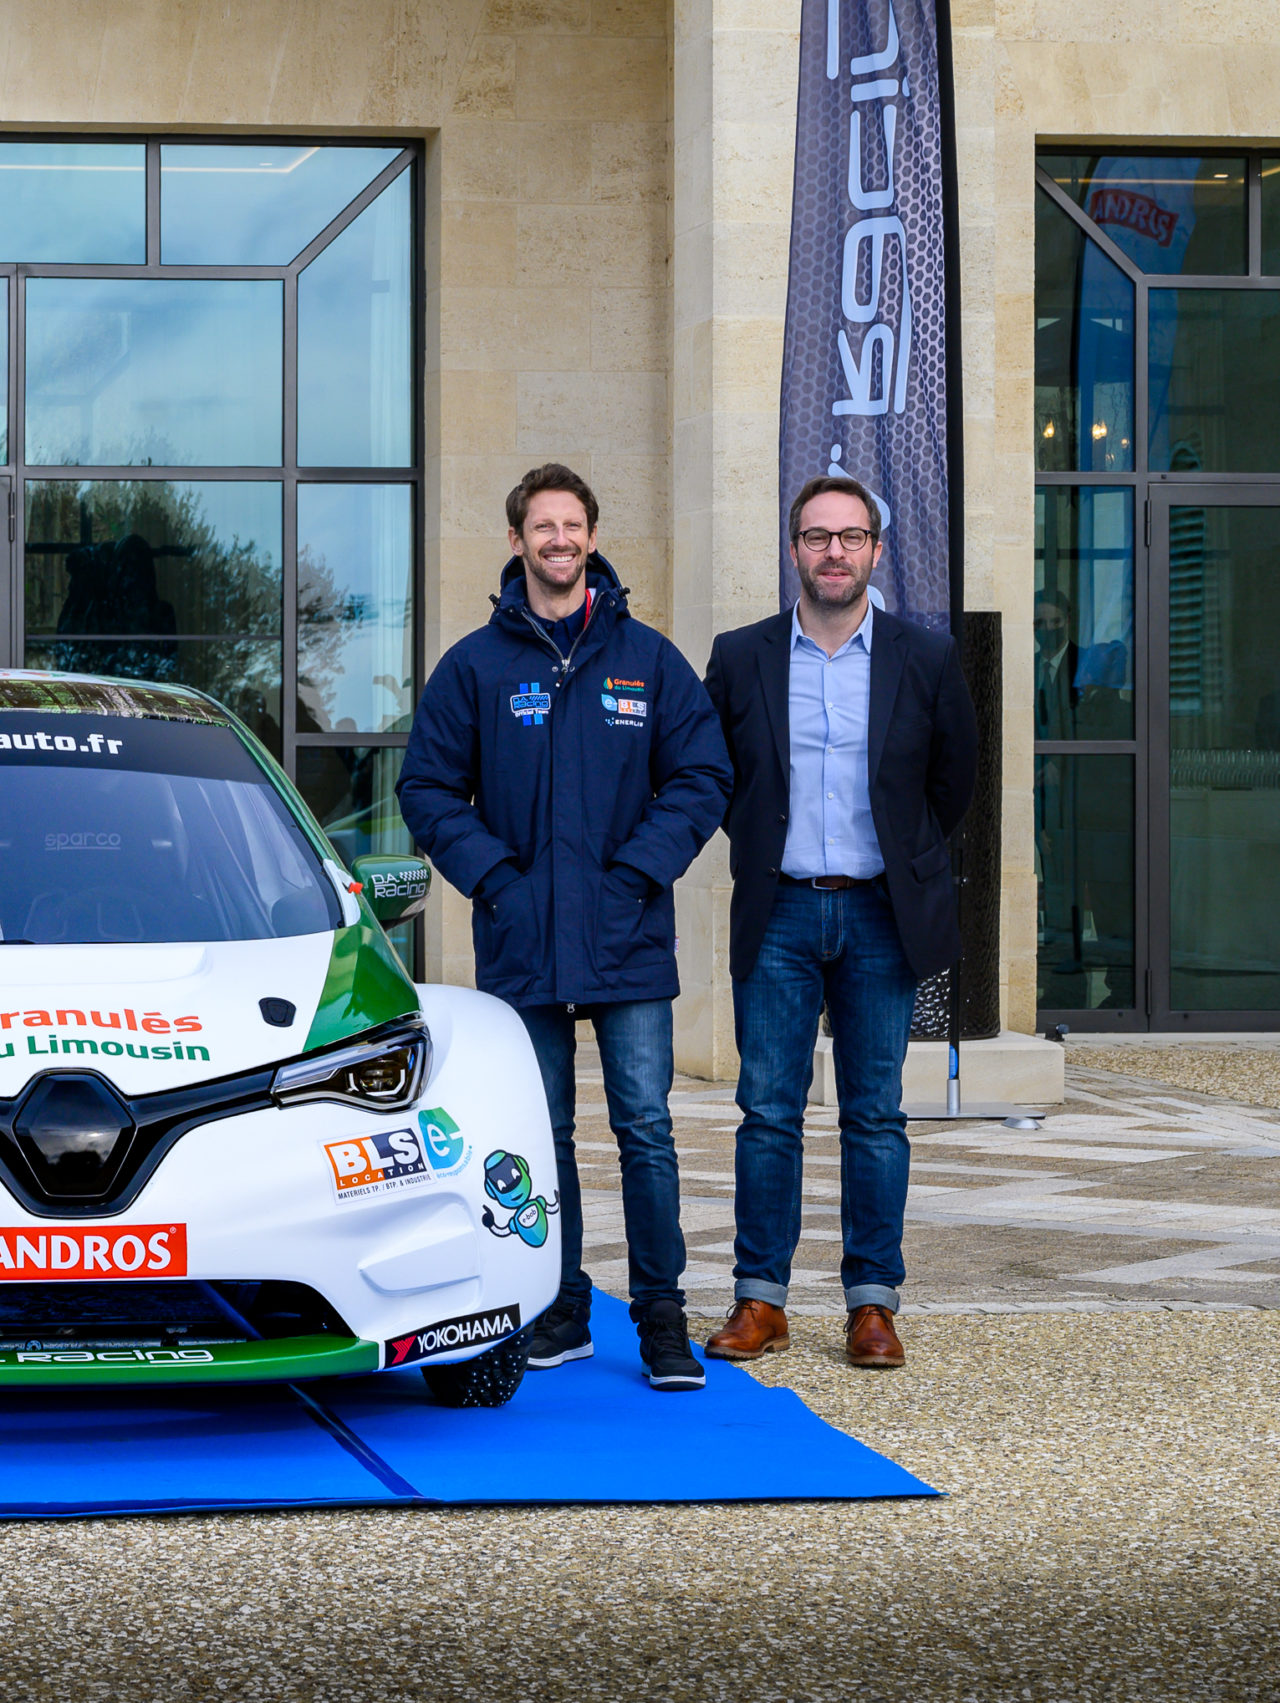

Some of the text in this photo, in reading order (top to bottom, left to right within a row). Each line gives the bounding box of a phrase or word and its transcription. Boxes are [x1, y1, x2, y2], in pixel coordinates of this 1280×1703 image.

[45, 832, 121, 851] sparco
[374, 882, 426, 899] Racing
[27, 1035, 210, 1061] Limousin
[329, 1132, 420, 1177] BLS
[338, 1187, 371, 1200] MATERIELS
[405, 1174, 432, 1186] INDUSTRIE
[339, 1163, 425, 1187] LOCATION
[522, 1208, 537, 1224] e-bob
[417, 1313, 514, 1354] YOKOHAMA
[17, 1349, 215, 1364] Racing
